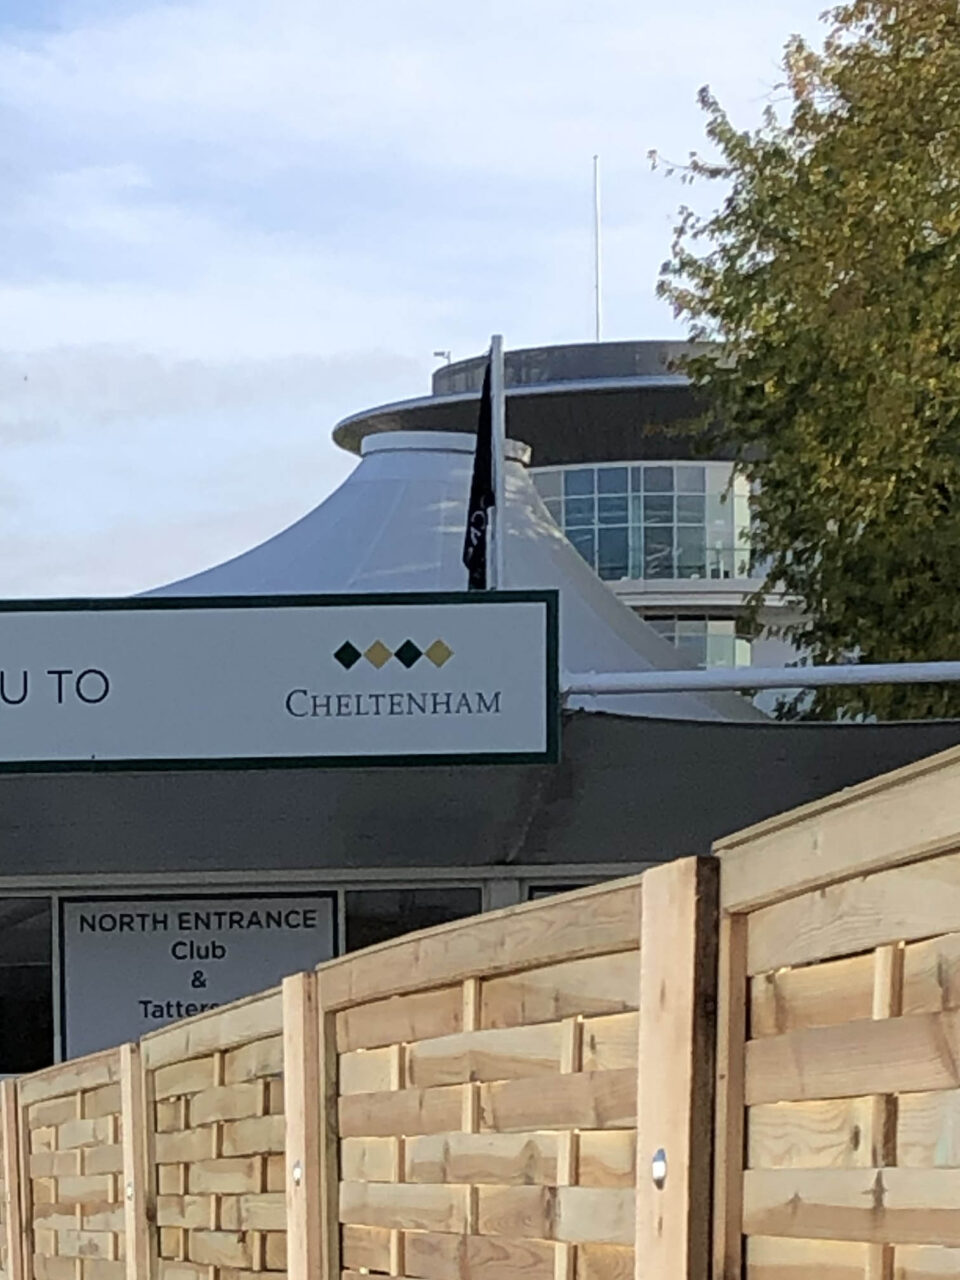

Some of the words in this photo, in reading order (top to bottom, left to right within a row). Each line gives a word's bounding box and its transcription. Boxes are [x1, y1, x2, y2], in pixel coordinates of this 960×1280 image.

[46, 668, 110, 704] TO
[285, 689, 501, 718] CHELTENHAM
[79, 912, 169, 933] NORTH
[177, 909, 317, 931] ENTRANCE
[171, 939, 227, 960] Club
[191, 969, 207, 989] &
